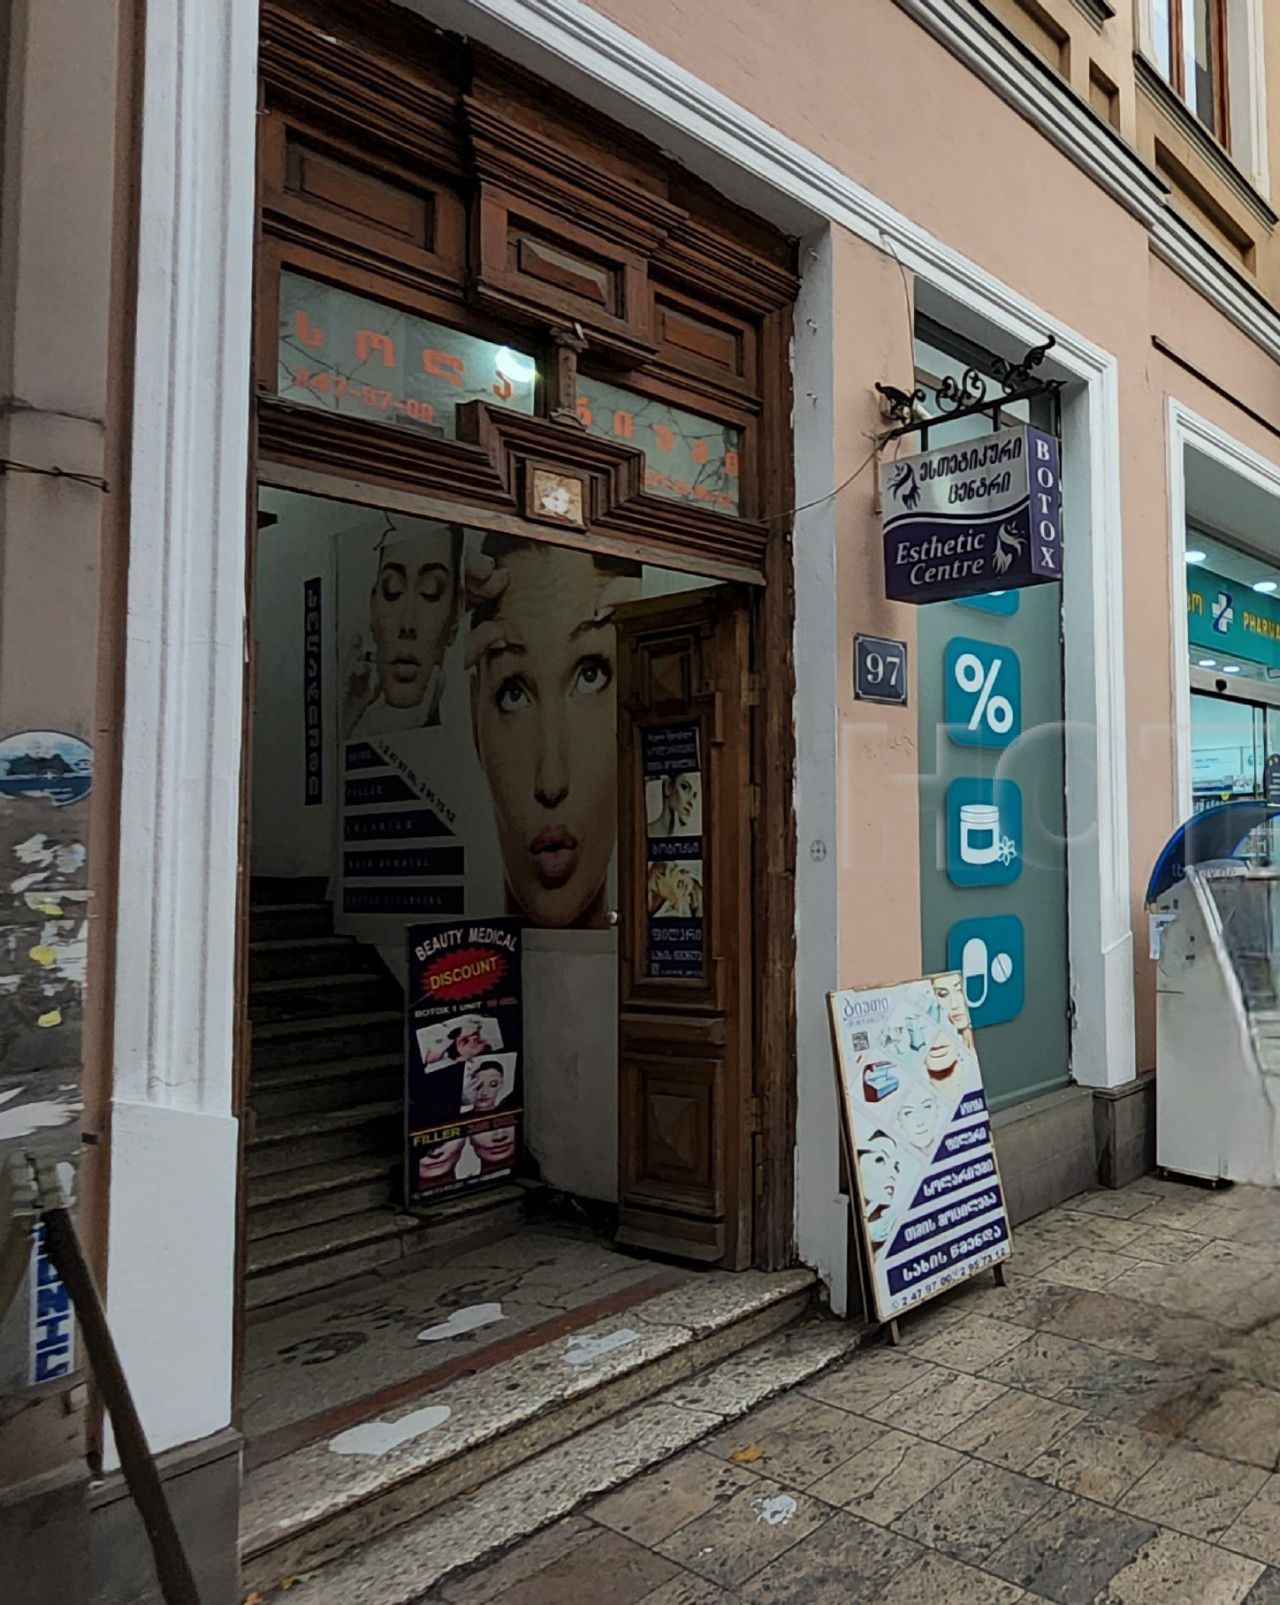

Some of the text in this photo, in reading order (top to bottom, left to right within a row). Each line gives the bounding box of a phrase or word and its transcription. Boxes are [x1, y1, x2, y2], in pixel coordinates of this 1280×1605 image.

[919, 436, 1022, 482] ესთეტიკური
[947, 471, 1011, 504] ცენტრი
[1036, 439, 1056, 569] BOTOX
[895, 529, 986, 565] Esthetic
[910, 558, 985, 586] Centre
[866, 652, 900, 686] 97
[415, 927, 517, 961] BEAUTY MEDICAL
[429, 956, 499, 990] DISCOUNT
[413, 1127, 461, 1147] FILLER
[902, 1225, 1002, 1281] სახის წმენდა
